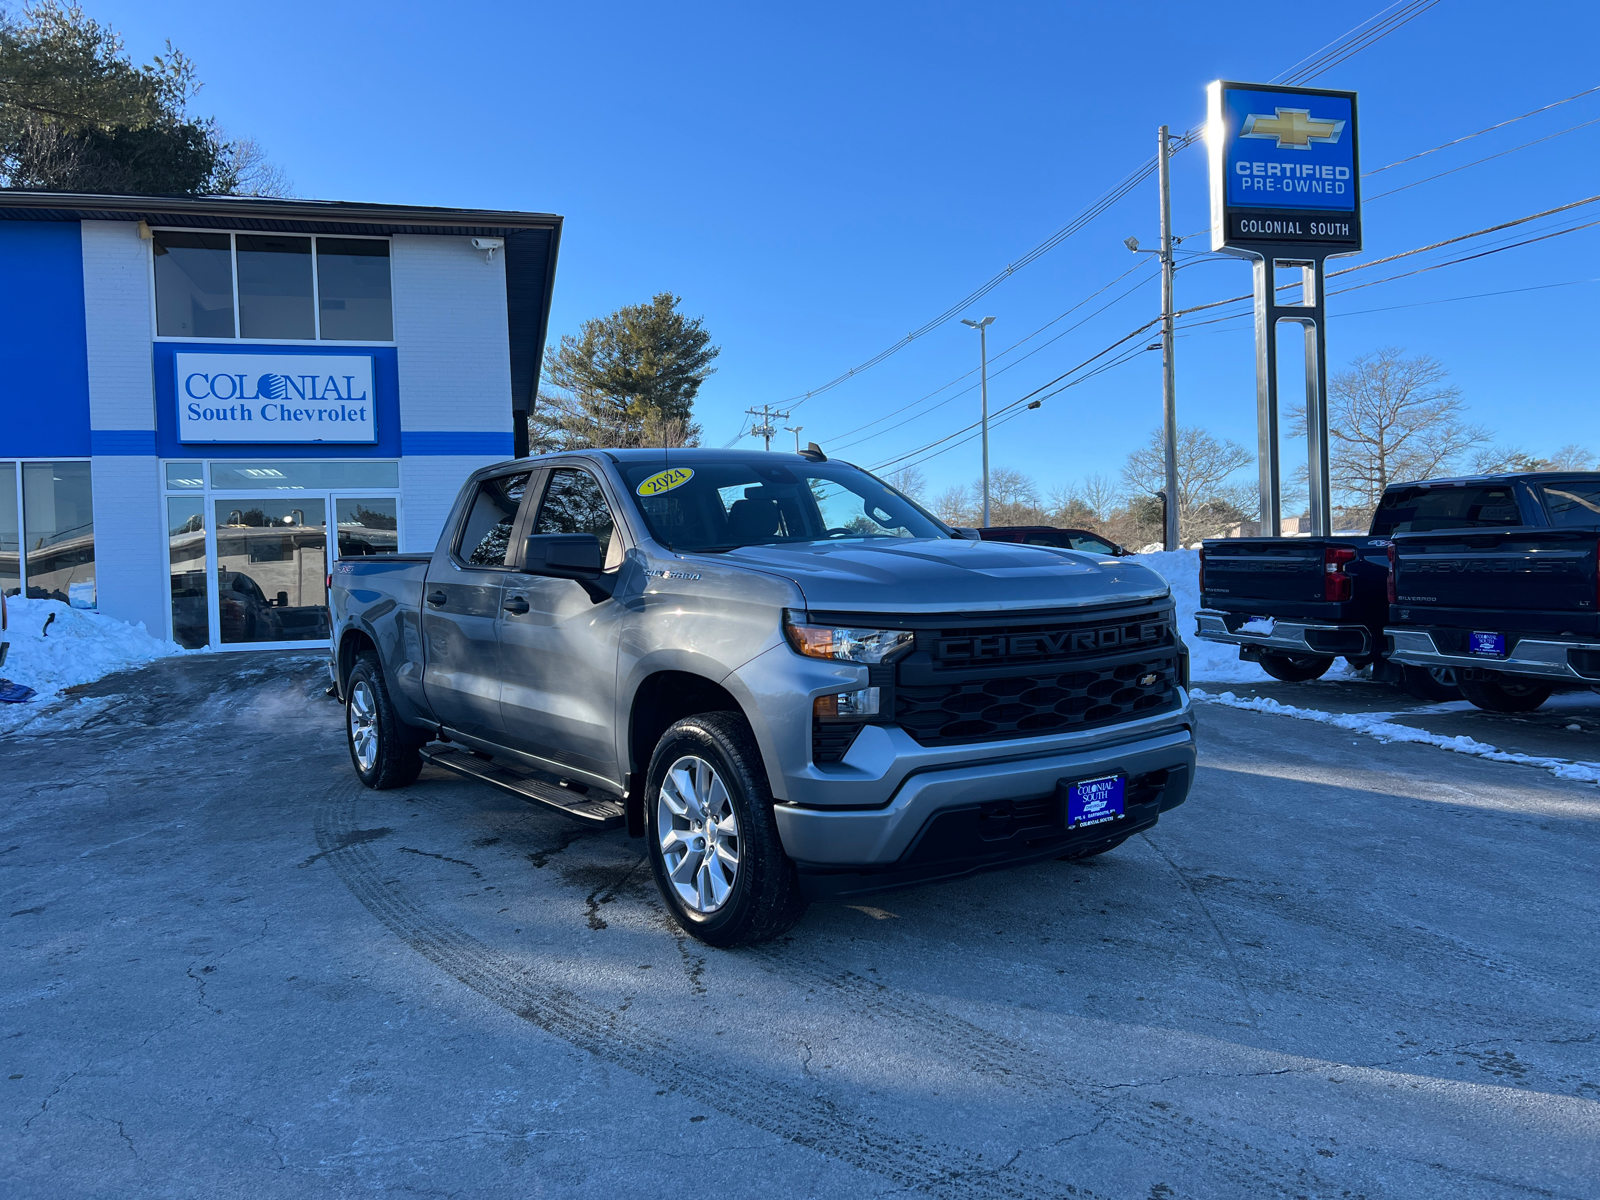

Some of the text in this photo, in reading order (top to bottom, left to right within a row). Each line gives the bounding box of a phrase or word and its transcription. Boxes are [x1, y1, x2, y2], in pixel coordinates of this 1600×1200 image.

[1235, 161, 1350, 180] CERTIFIED
[1242, 177, 1345, 194] PRE-OWNED
[1240, 219, 1349, 236] COLONIAL SOUTH
[185, 373, 367, 401] COLONIAL
[187, 403, 367, 422] South Chevrolet
[647, 469, 687, 493] 2024
[644, 569, 701, 581] SILVERADO
[1401, 561, 1577, 573] CHEVROLET
[938, 620, 1170, 660] CHEVROLET
[1078, 782, 1113, 795] COLONIAL
[1083, 791, 1107, 802] SOUTH
[742, 811, 754, 896] BRIDGESTONE
